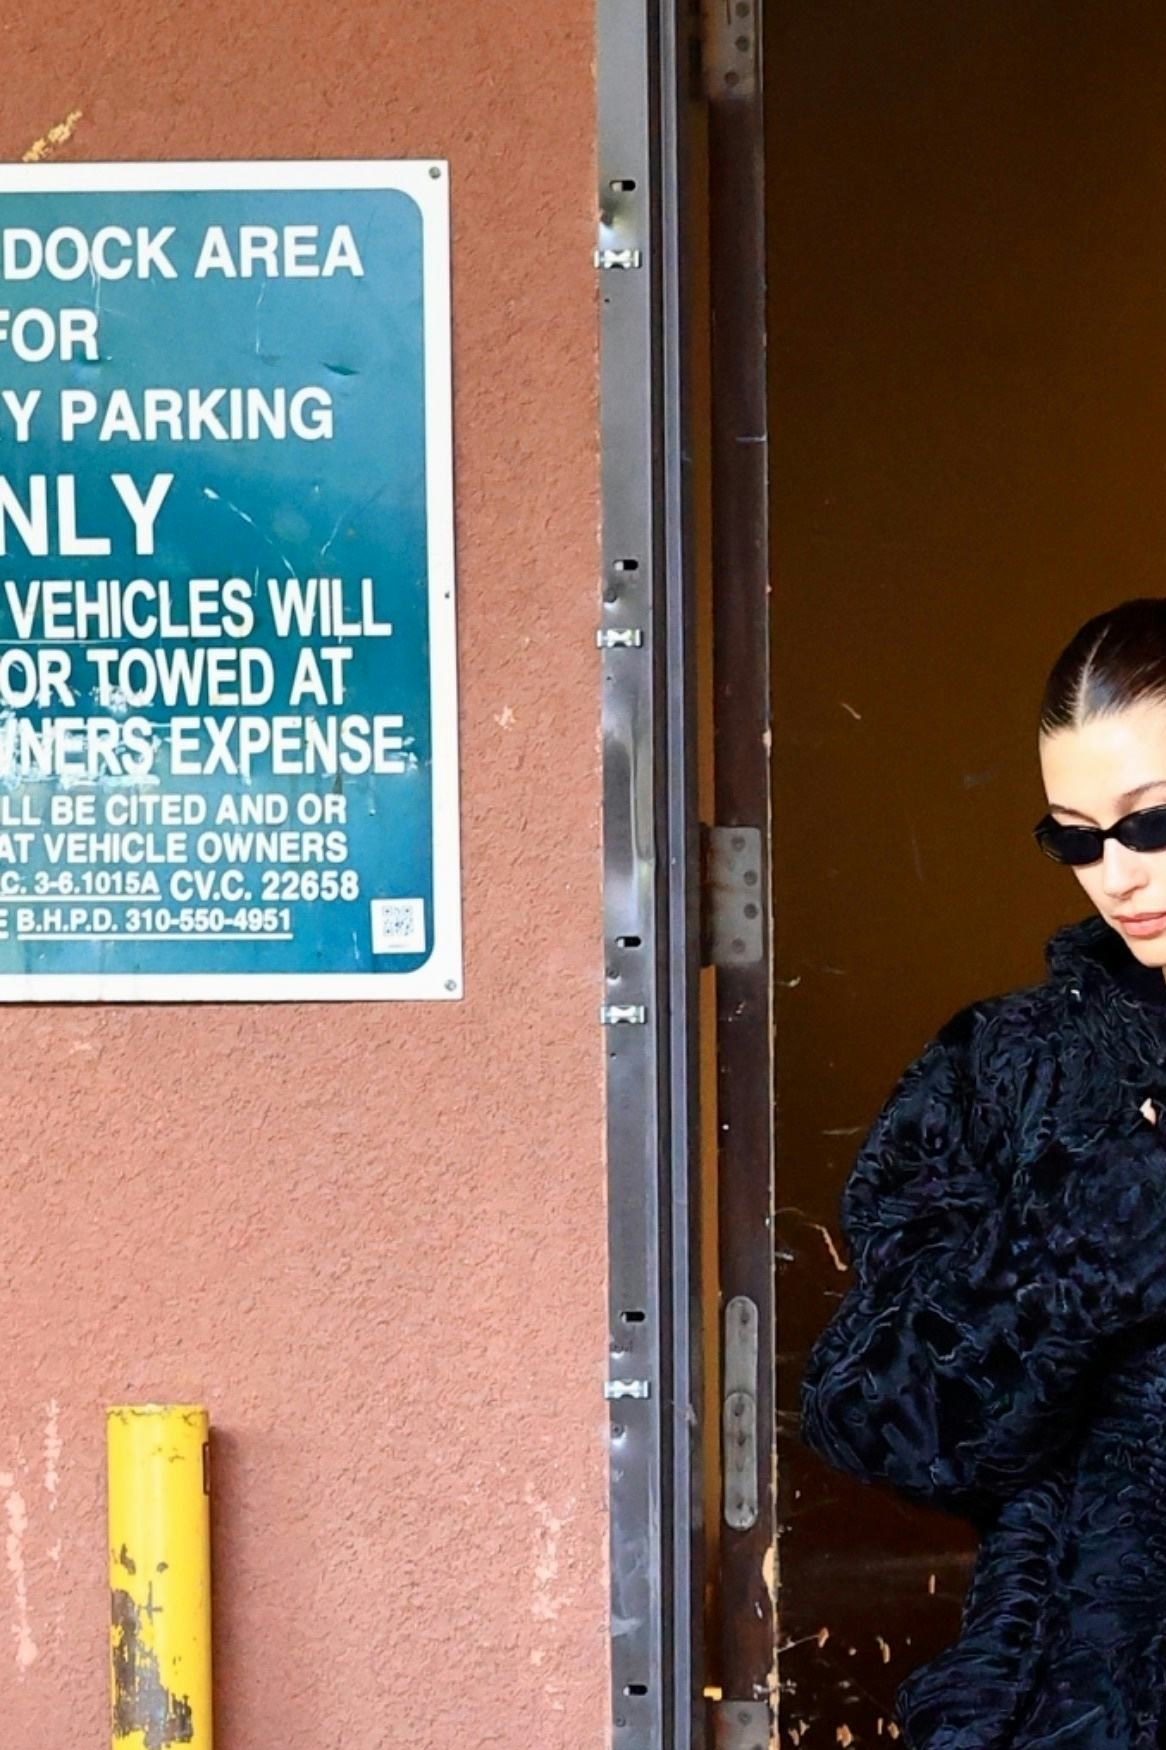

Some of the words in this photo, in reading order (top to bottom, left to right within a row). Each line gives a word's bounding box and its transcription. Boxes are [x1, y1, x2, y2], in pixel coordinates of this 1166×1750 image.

[3, 226, 178, 281] DOCK
[194, 225, 364, 278] AREA
[2, 390, 41, 441] Y
[61, 386, 333, 441] PARKING
[0, 474, 174, 556] NLY
[4, 579, 254, 639] VEHICLES
[268, 578, 392, 637] WILL
[0, 649, 75, 708] OR
[87, 648, 274, 707] TOWED
[289, 647, 353, 705] AT
[169, 715, 405, 775] EXPENSE
[51, 794, 96, 826] BE
[105, 793, 207, 826] CITED
[215, 793, 289, 825] AND
[297, 792, 347, 825] OR
[0, 832, 35, 864] AT
[43, 831, 188, 864] VEHICLE
[196, 830, 348, 864] OWNERS
[34, 870, 160, 895] 3-6.1015A
[261, 869, 359, 901] 22658
[16, 907, 118, 933] B.H.P.D.
[125, 907, 290, 932] 310-550-4951
